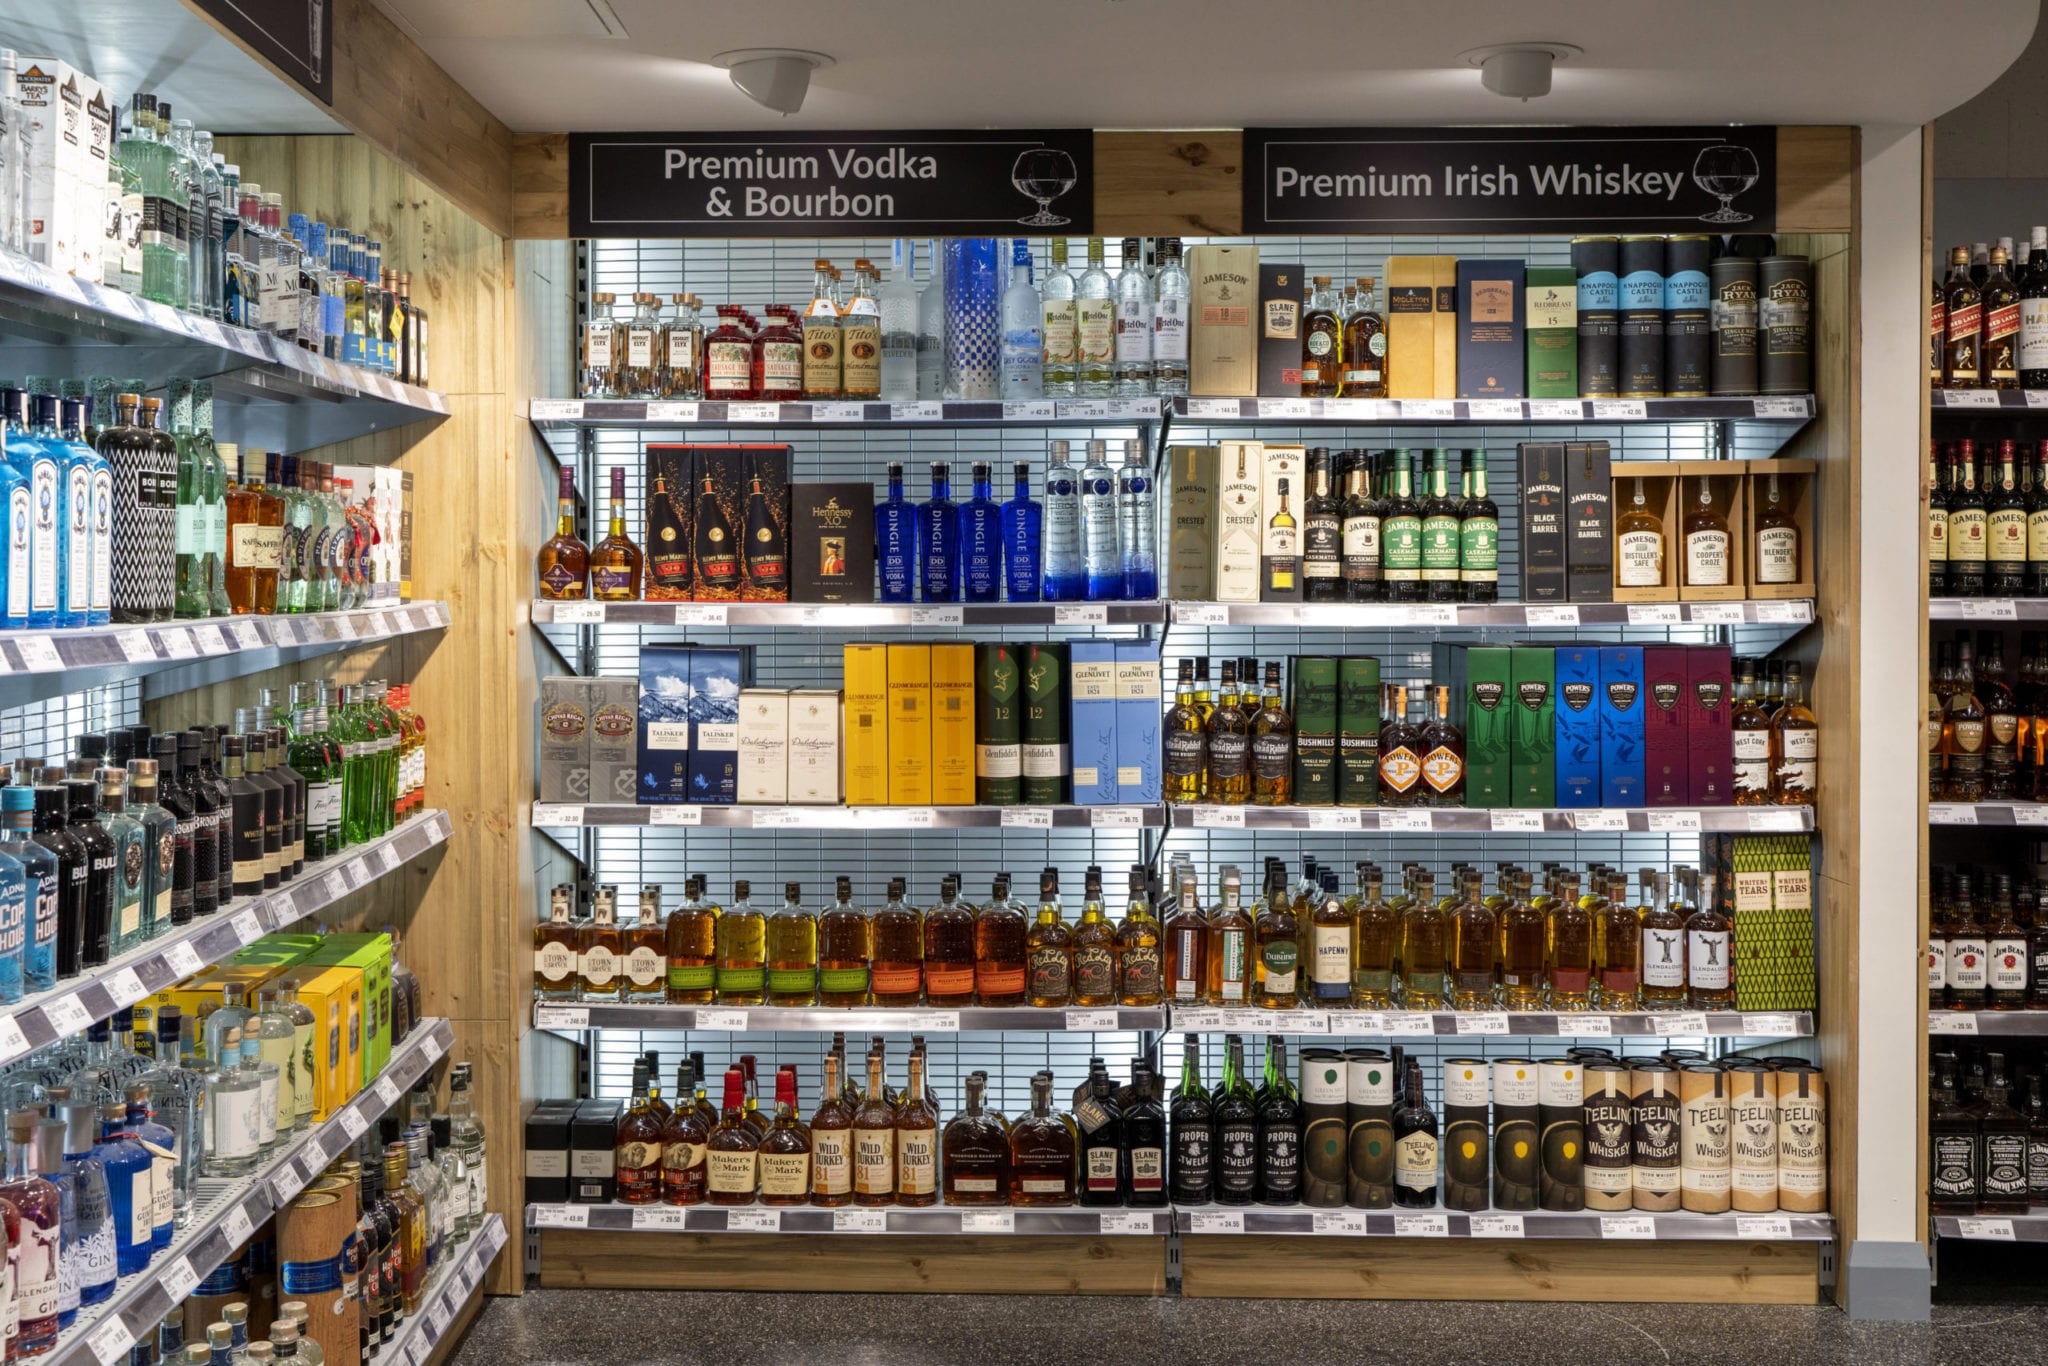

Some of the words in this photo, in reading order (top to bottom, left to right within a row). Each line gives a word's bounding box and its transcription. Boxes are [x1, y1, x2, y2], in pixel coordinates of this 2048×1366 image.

[664, 148, 819, 180] Premium
[828, 147, 939, 180] Vodka
[1276, 165, 1432, 197] Premium
[1444, 164, 1519, 196] Irish
[1529, 163, 1684, 201] Whiskey
[705, 186, 734, 217] &
[745, 186, 895, 217] Bourbon
[1202, 273, 1247, 285] JAMESON
[1475, 286, 1511, 297] REDBREAST
[1730, 285, 1750, 293] JACK
[1771, 288, 1807, 298] RYAN
[1723, 290, 1757, 300] RYAN
[1269, 304, 1294, 312] SLANE
[1533, 301, 1573, 309] REDBREAST
[1220, 308, 1230, 318] 18
[1963, 312, 1982, 323] LABEL
[1547, 317, 1558, 326] 15
[808, 330, 837, 342] Tito's
[848, 330, 878, 342] Tito's
[1268, 453, 1300, 462] JAMESON
[1224, 483, 1257, 492] JAMESON
[1527, 484, 1561, 494] JAMESON
[1570, 493, 1608, 504] JAMESON
[812, 507, 852, 517] Hennessy
[1177, 516, 1205, 525] CRESTED
[1226, 516, 1254, 524] CRESTED
[1534, 514, 1555, 523] BLACK
[889, 510, 899, 553] DINGLE
[932, 510, 942, 553] DINGLE
[975, 510, 985, 553] DINGLE
[1016, 509, 1026, 552] DINGLE
[1532, 525, 1558, 533] BARREL
[1578, 531, 1602, 539] BARREL
[1624, 535, 1657, 545] JAMESON
[1692, 535, 1726, 545] JAMESON
[1762, 532, 1795, 542] JAMESON
[1625, 551, 1658, 559] DISTILLER'S
[1696, 551, 1724, 559] COOPER'S
[1634, 559, 1649, 567] SAFE
[1075, 671, 1111, 679] GLENLIVET
[1119, 670, 1155, 679] GLENLIVET
[1476, 684, 1501, 692] POWERS
[1521, 684, 1546, 692] POWERS
[1566, 685, 1591, 693] POWERS
[1610, 684, 1635, 693] POWERS
[1655, 684, 1677, 692] POWERS
[1699, 684, 1721, 692] POWERS
[567, 713, 583, 721] REGAL
[995, 708, 1010, 720] 12
[1029, 708, 1042, 720] 12
[1993, 716, 2018, 724] POWERS
[1958, 723, 1983, 731] POWERS
[652, 730, 685, 738] TALISKER
[702, 731, 735, 739] TALISKER
[1297, 737, 1335, 746] BUSHMILLS
[1341, 738, 1379, 747] BUSHMILLS
[984, 747, 1018, 758] Glenfiddich
[1385, 752, 1420, 764] POWERS
[1396, 761, 1410, 777] P
[1437, 761, 1450, 777] P
[1740, 886, 1768, 896] TEARS
[1778, 885, 1807, 894] TEARS
[1319, 946, 1349, 955] HAPENNY
[1954, 946, 1966, 958] JIM
[1967, 945, 1985, 958] BEAM
[1958, 974, 1981, 982] BOURBON
[1179, 1131, 1209, 1142] PROPER
[1224, 1131, 1254, 1142] PROPER
[1267, 1131, 1297, 1142] PROPER
[818, 1142, 841, 1154] WILD
[859, 1142, 882, 1154] WILD
[905, 1142, 929, 1154] WILD
[1404, 1142, 1434, 1151] TEELING
[1589, 1142, 1631, 1158] WHISKEY
[1637, 1142, 1679, 1158] WHISKEY
[1782, 1142, 1824, 1158] WHISKEY
[711, 1155, 752, 1165] Maker's
[815, 1153, 844, 1165] TURKEY
[856, 1152, 885, 1165] TURKEY
[902, 1153, 932, 1165] TURKEY
[1089, 1150, 1114, 1160] SLANE
[1133, 1151, 1159, 1160] SLANE
[763, 1157, 804, 1167] Maker's
[1181, 1154, 1209, 1167] TWELVE
[1225, 1155, 1254, 1167] TWELVE
[815, 1166, 828, 1181] 81
[856, 1165, 869, 1180] 81
[902, 1165, 916, 1180] 81
[1934, 1176, 1958, 1193] DANIEL'S
[1958, 1177, 1975, 1190] JACK
[89, 1254, 111, 1268] GIN
